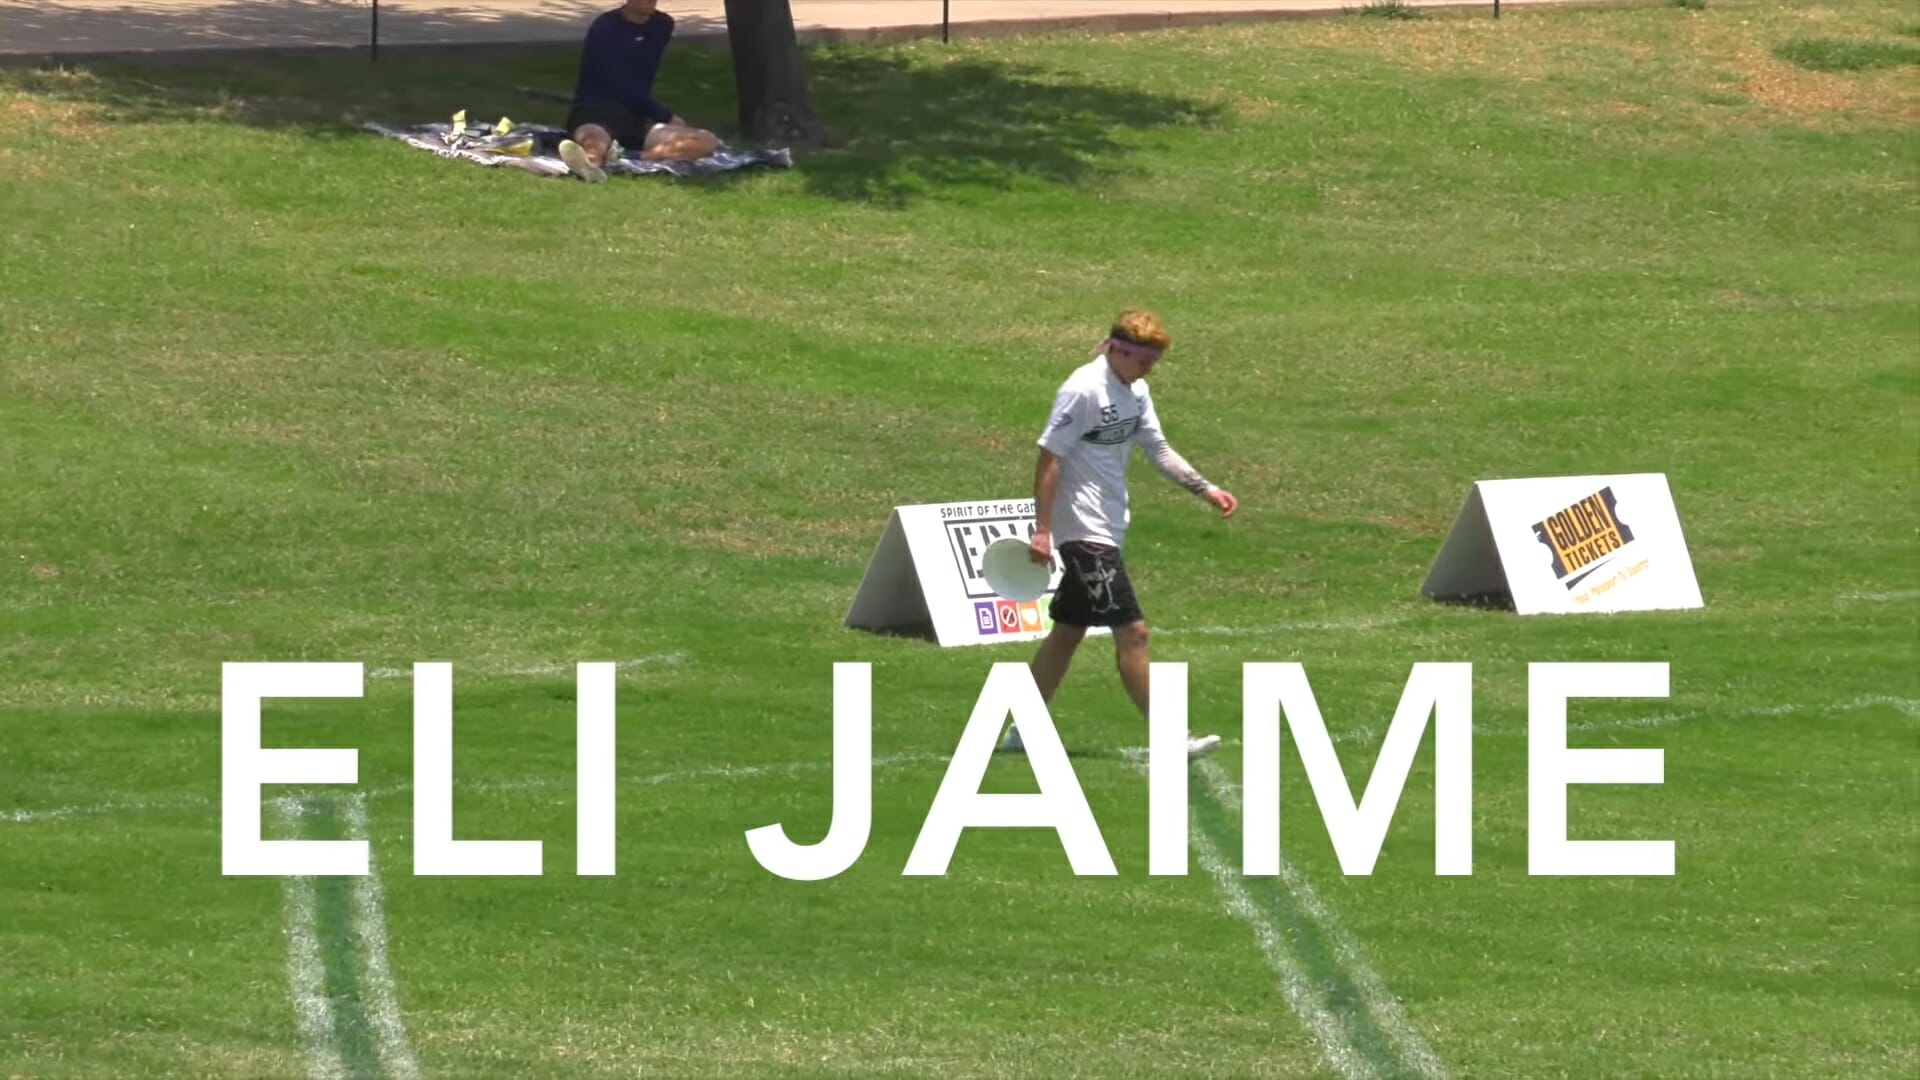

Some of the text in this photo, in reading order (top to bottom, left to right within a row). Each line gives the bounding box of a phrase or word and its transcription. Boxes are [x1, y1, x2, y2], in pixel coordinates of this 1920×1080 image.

[1100, 404, 1119, 423] 55
[940, 506, 973, 518] SPIRIT
[977, 505, 990, 516] OF
[1547, 493, 1612, 551] GOLDEN
[1564, 531, 1621, 571] TICKETS
